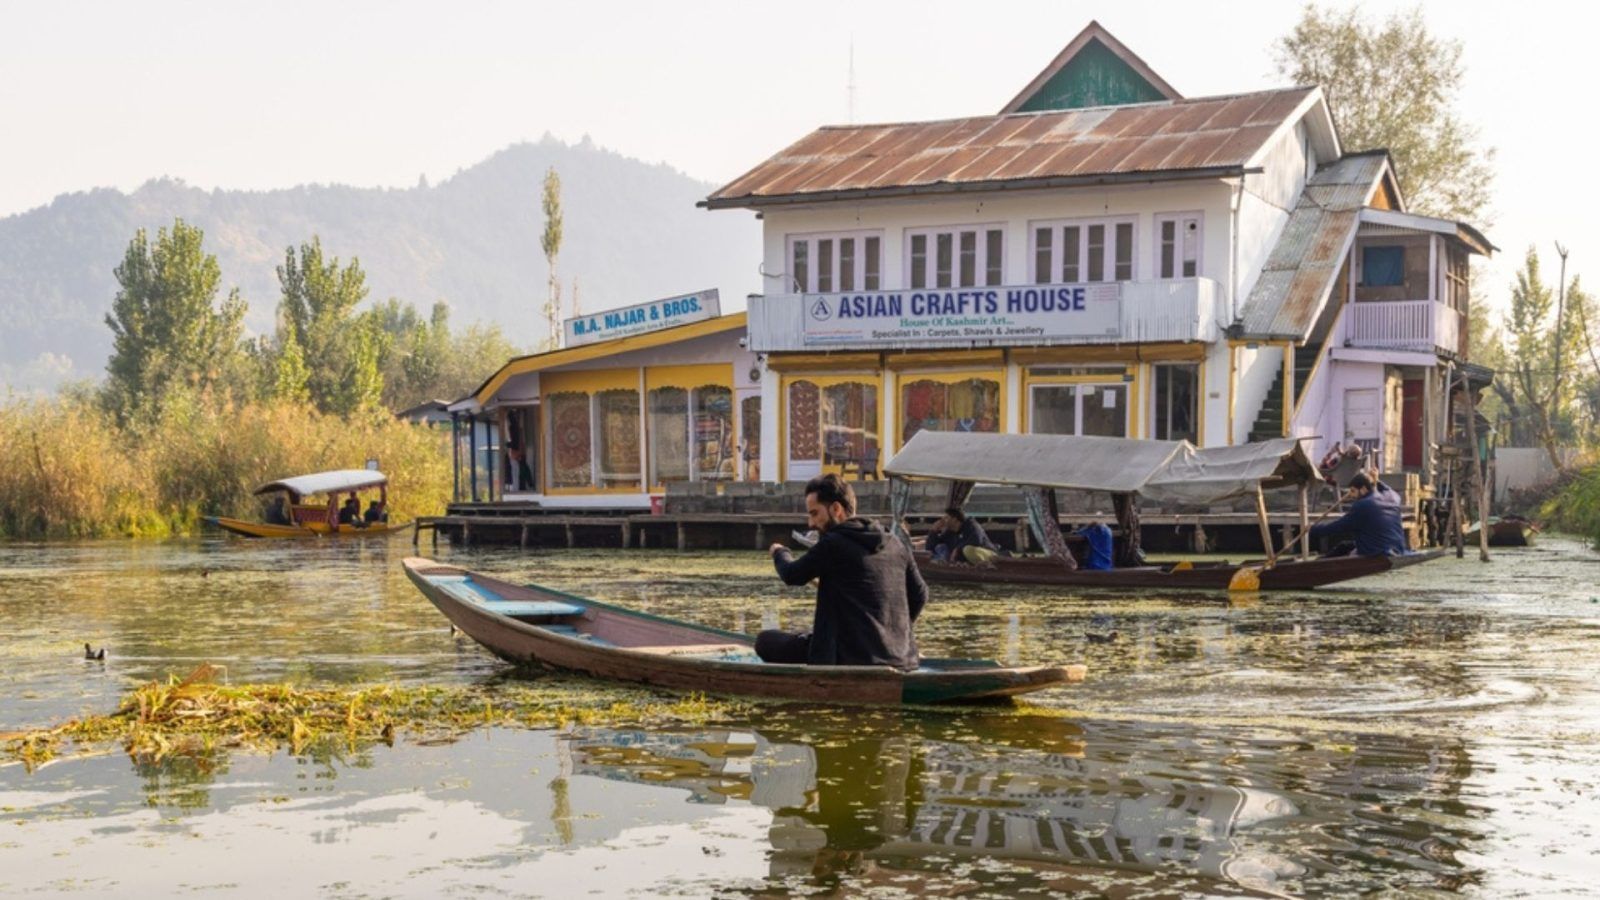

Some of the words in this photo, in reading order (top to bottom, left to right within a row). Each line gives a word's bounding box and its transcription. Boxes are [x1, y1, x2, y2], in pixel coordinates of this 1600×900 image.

[838, 295, 902, 318] ASIAN
[911, 291, 998, 316] CRAFTS
[1007, 288, 1085, 313] HOUSE
[574, 319, 601, 336] M.A.
[605, 308, 646, 329] NAJAR
[650, 304, 659, 320] &
[663, 297, 702, 318] BROS.
[900, 317, 930, 327] House
[932, 317, 943, 327] Of
[946, 316, 987, 326] Kashmir
[872, 329, 911, 339] Specialist
[927, 329, 961, 338] Carpets,
[964, 327, 993, 336] Shawls
[996, 327, 1003, 336] &
[1005, 326, 1045, 336] Jewellery
